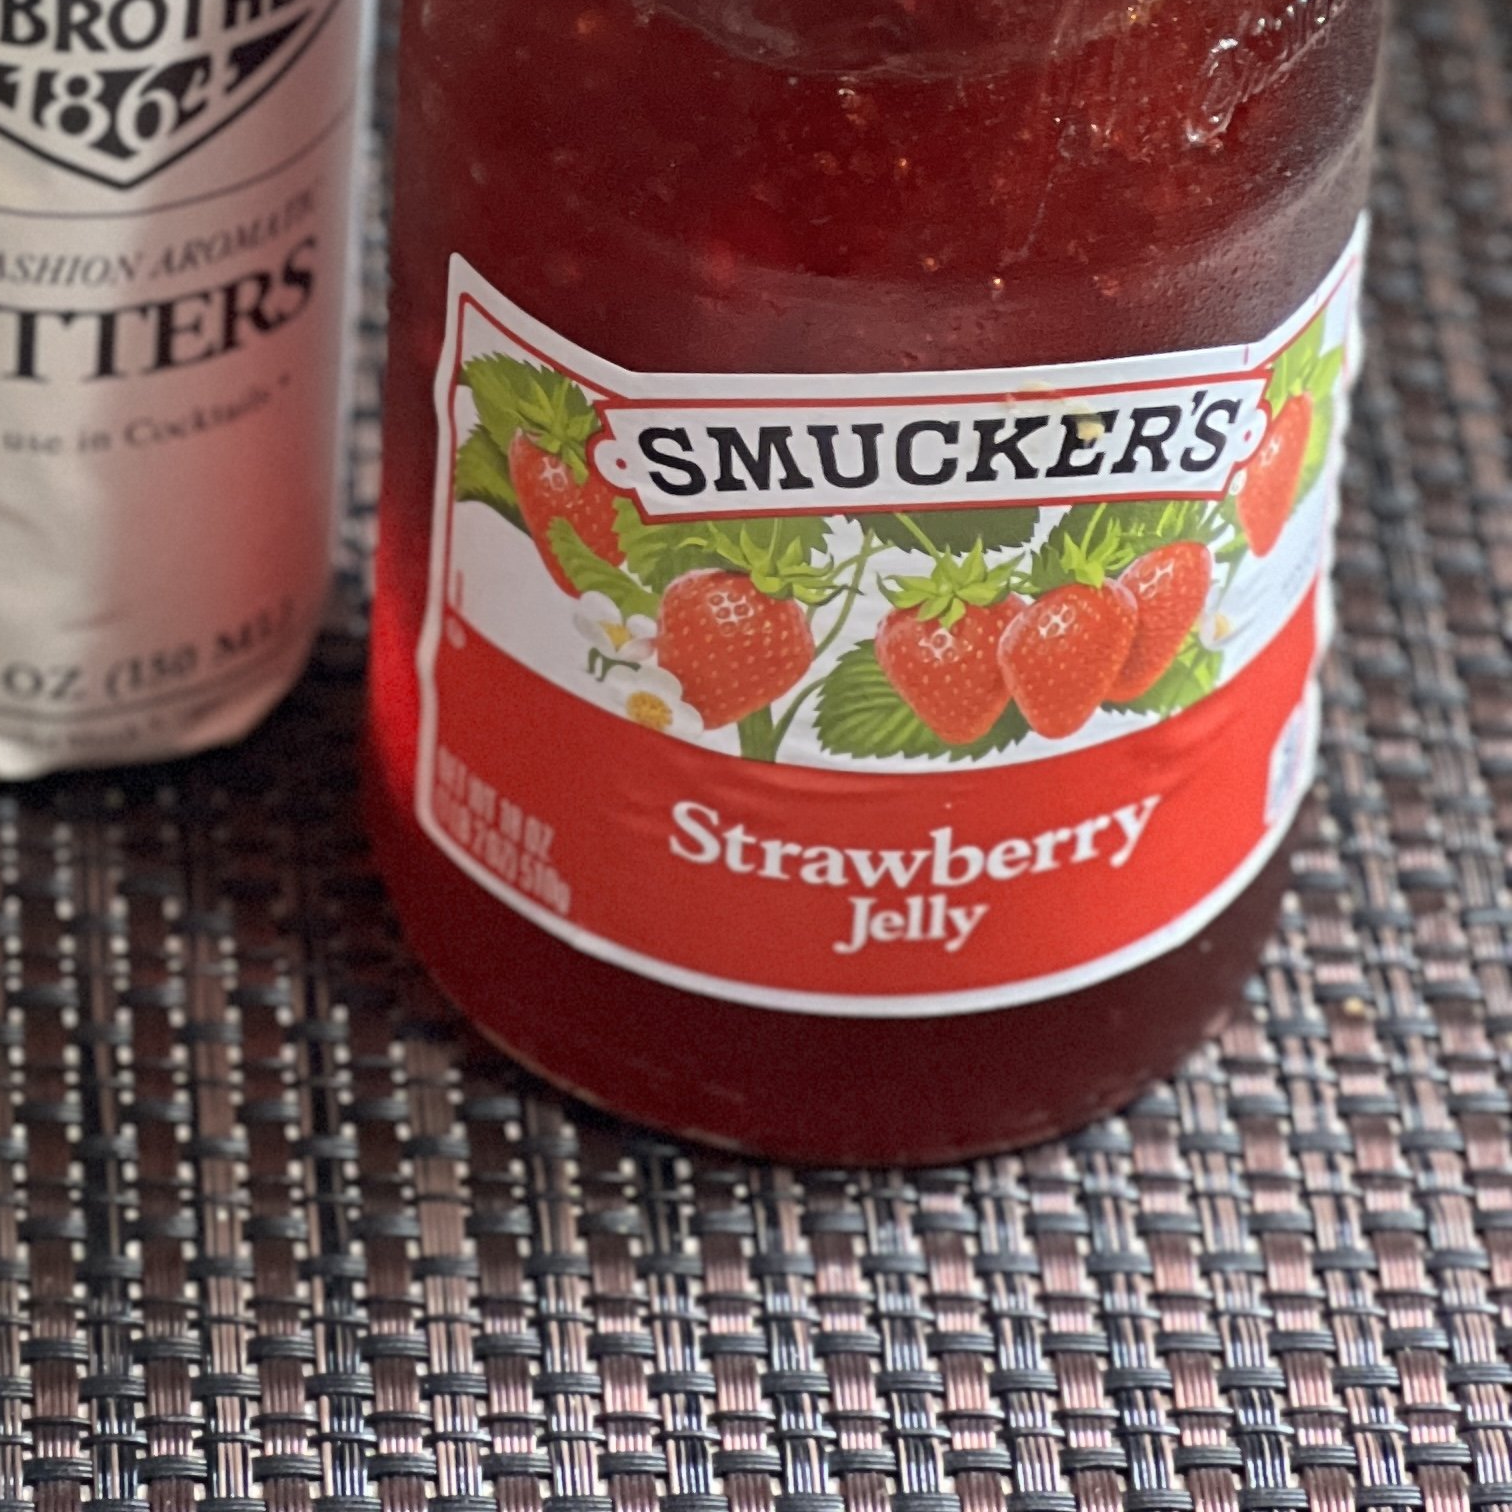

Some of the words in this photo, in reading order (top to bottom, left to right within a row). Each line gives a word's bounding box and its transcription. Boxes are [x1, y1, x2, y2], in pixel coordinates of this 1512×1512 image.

[3, 423, 63, 454] use
[78, 423, 112, 453] in
[637, 391, 1243, 497] SMUCKER'S
[668, 793, 1163, 888] Strawberry
[831, 894, 990, 954] Jelly
